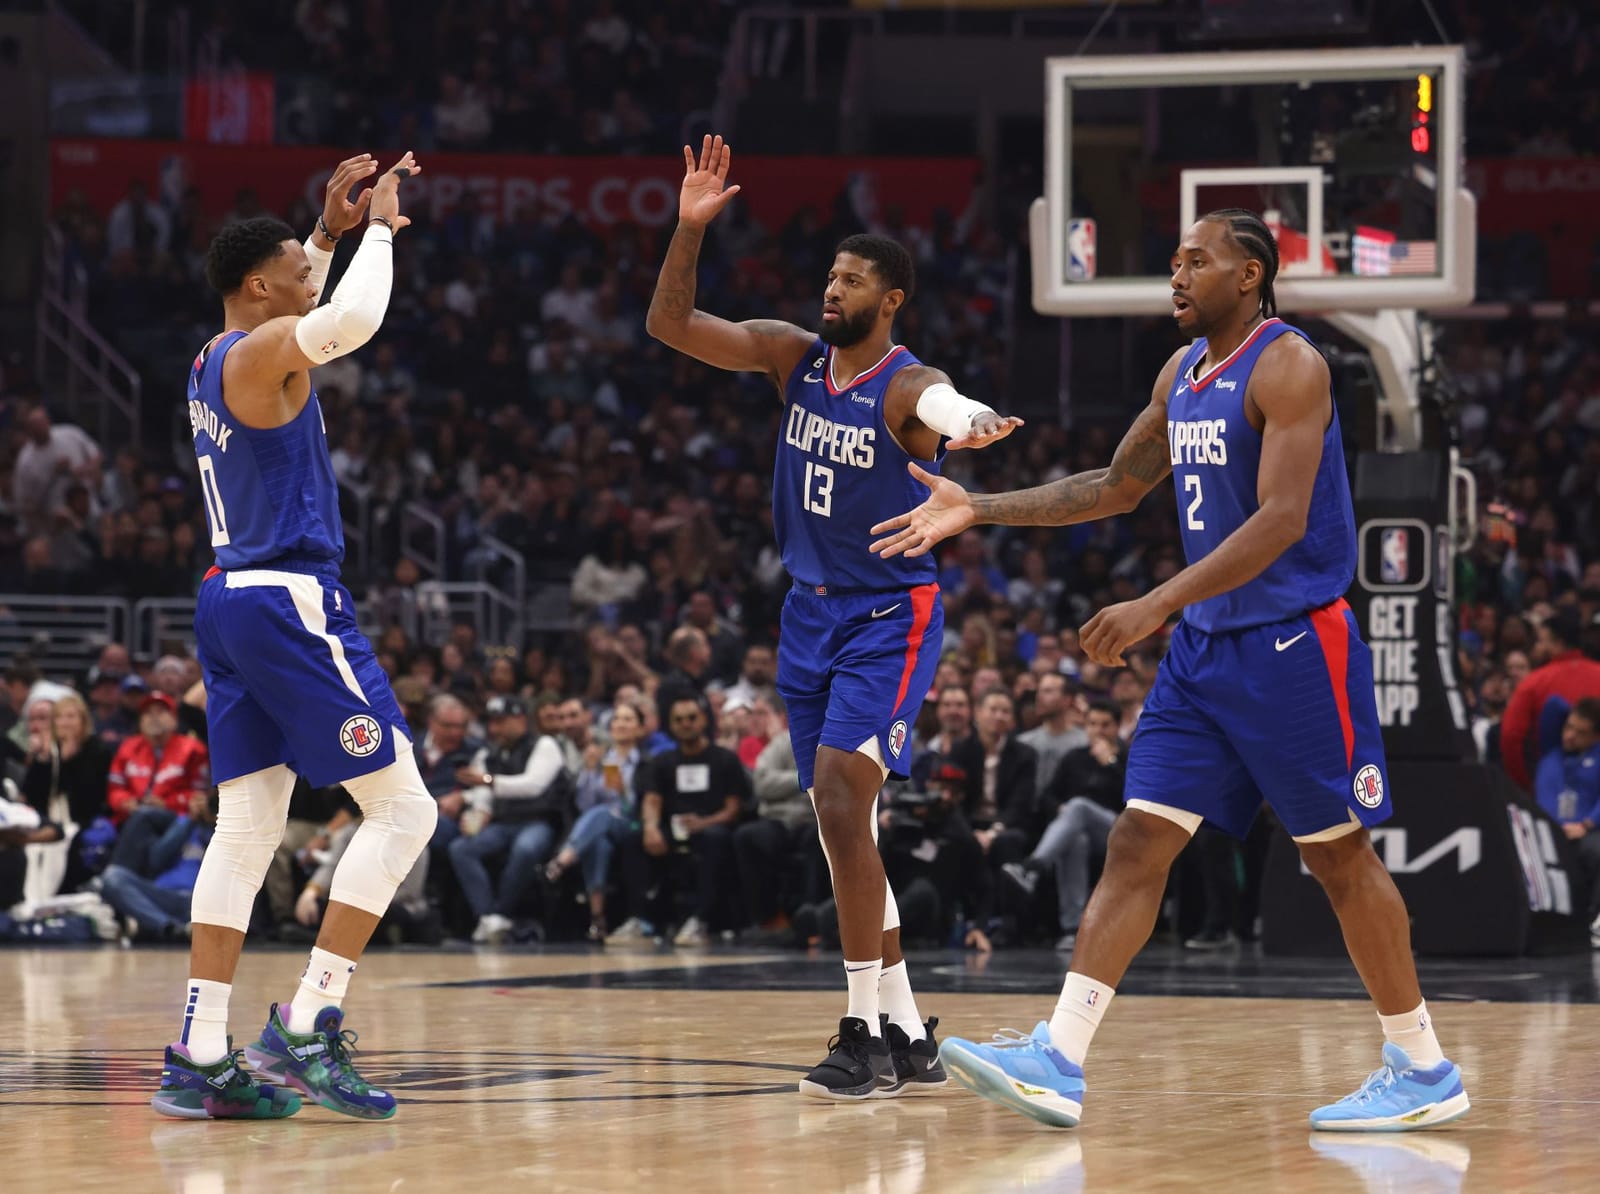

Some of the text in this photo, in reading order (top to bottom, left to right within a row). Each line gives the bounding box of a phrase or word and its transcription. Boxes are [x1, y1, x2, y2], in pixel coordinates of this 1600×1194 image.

[812, 357, 826, 369] 6
[851, 391, 876, 408] honey
[785, 402, 876, 469] CLIPPERS
[198, 454, 231, 547] 0
[803, 461, 834, 518] 13
[1184, 475, 1205, 530] 2
[1368, 596, 1419, 639] GET
[1368, 640, 1419, 682] THE
